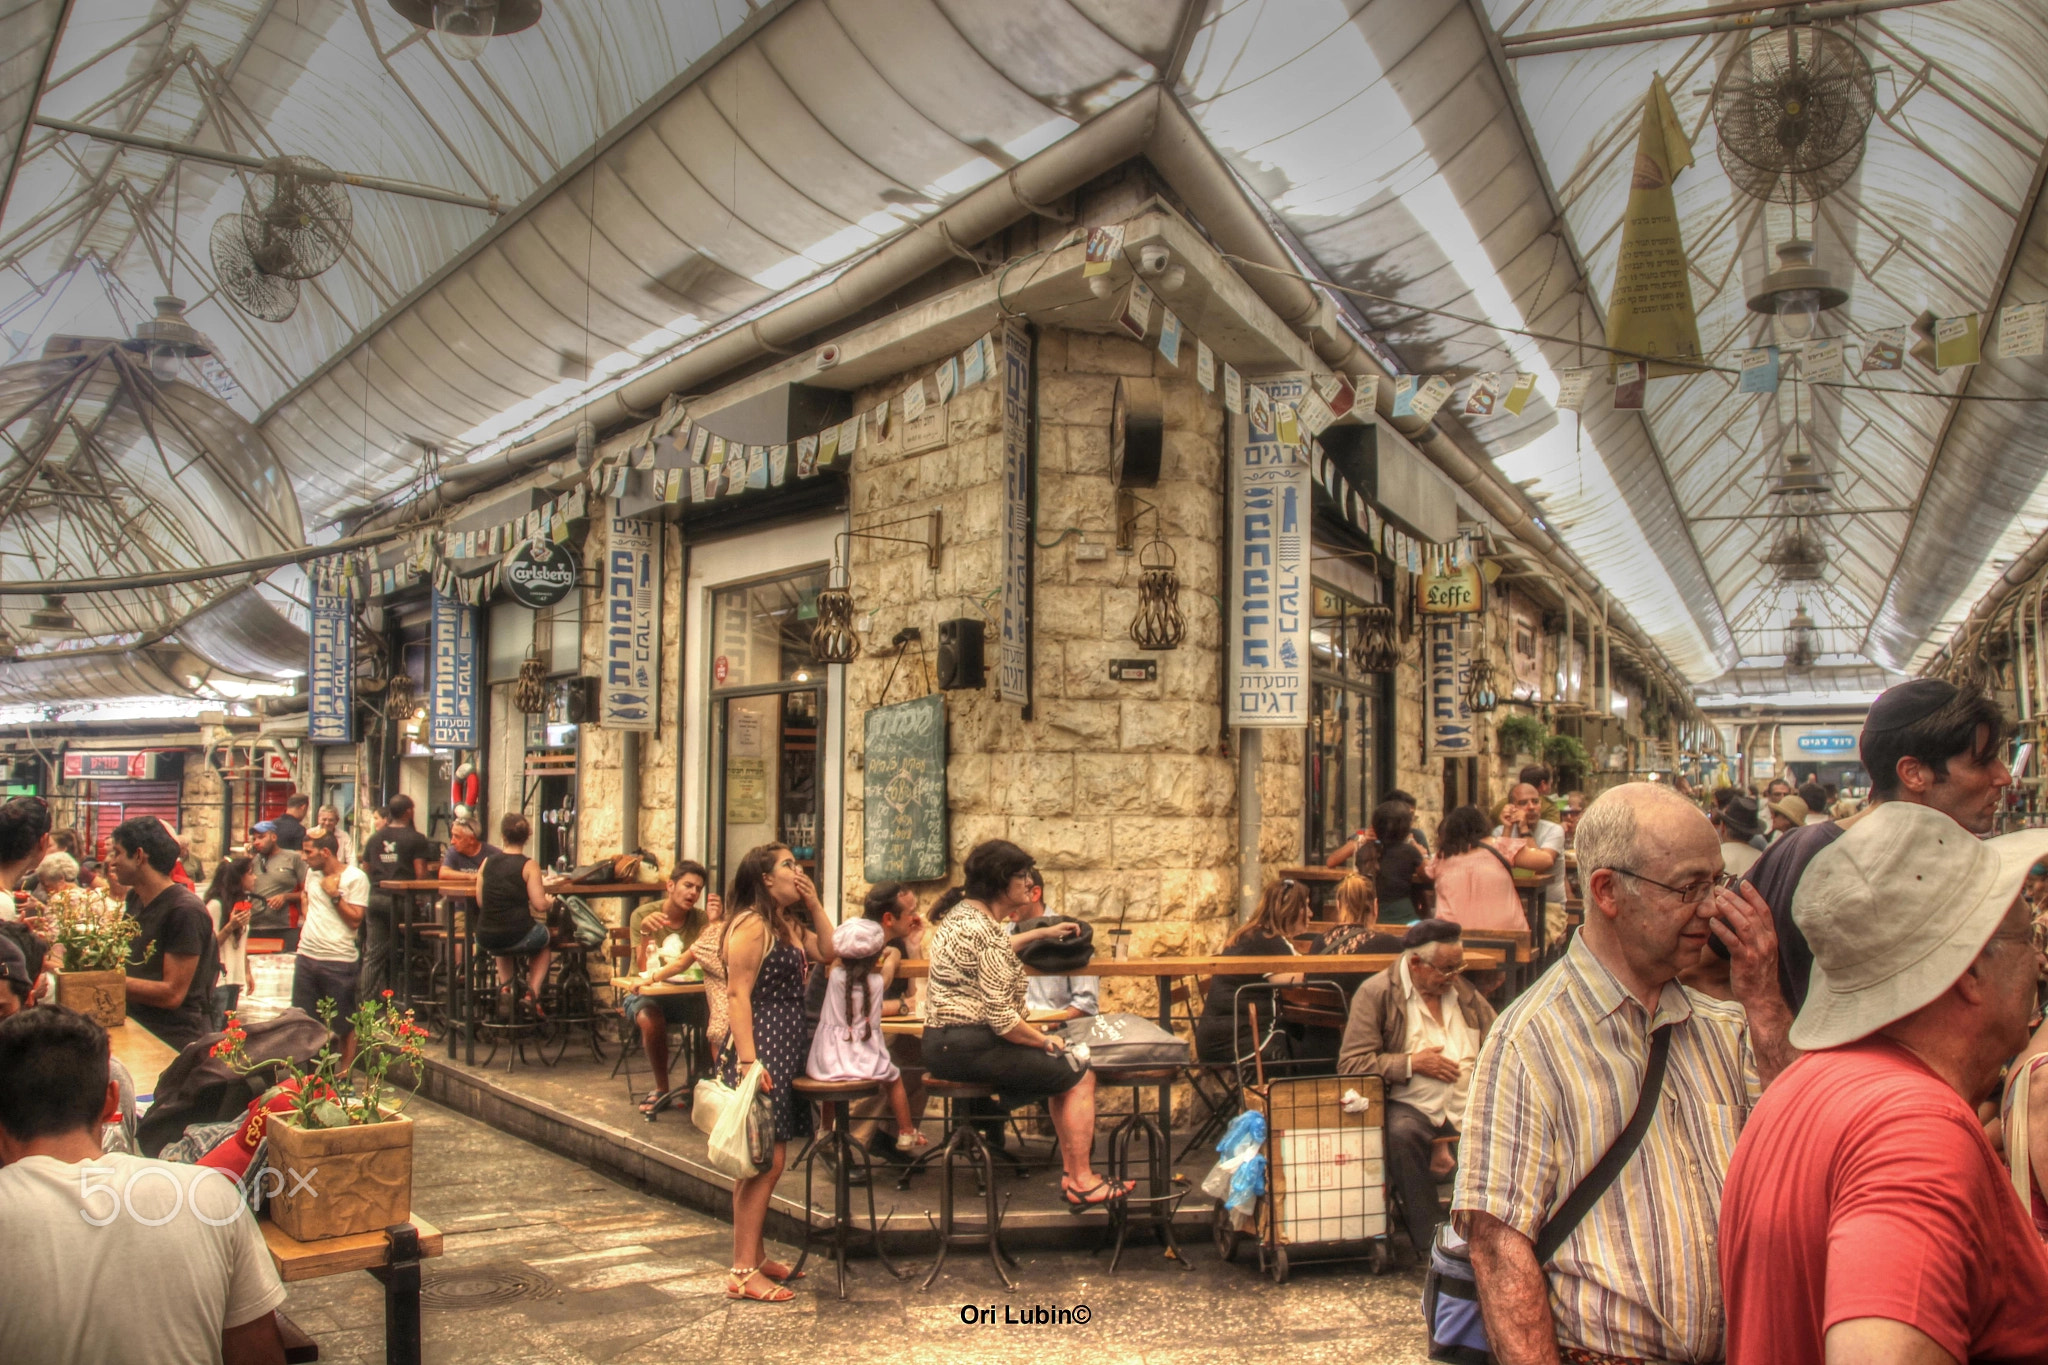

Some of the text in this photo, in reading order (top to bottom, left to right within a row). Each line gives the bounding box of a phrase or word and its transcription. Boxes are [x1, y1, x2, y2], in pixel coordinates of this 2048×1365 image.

[612, 518, 653, 538] דגים
[510, 561, 572, 585] Carlsberg
[315, 597, 346, 610] דגים
[1243, 513, 1271, 669] מכמורת
[1279, 576, 1299, 633] כשר
[1427, 585, 1471, 607] Leffe
[608, 550, 634, 687] מכמורת
[636, 620, 650, 662] כשר
[313, 618, 333, 715] מכמורת
[436, 623, 457, 716] מכמורת
[458, 661, 471, 696] כשר
[1433, 613, 1454, 718] כמורת
[334, 666, 346, 697] כשר
[1240, 675, 1298, 690] מסעדת
[1240, 692, 1298, 713] דגים
[435, 718, 470, 728] מסעדת
[435, 728, 470, 743] דגים
[1801, 737, 1828, 746] דגים
